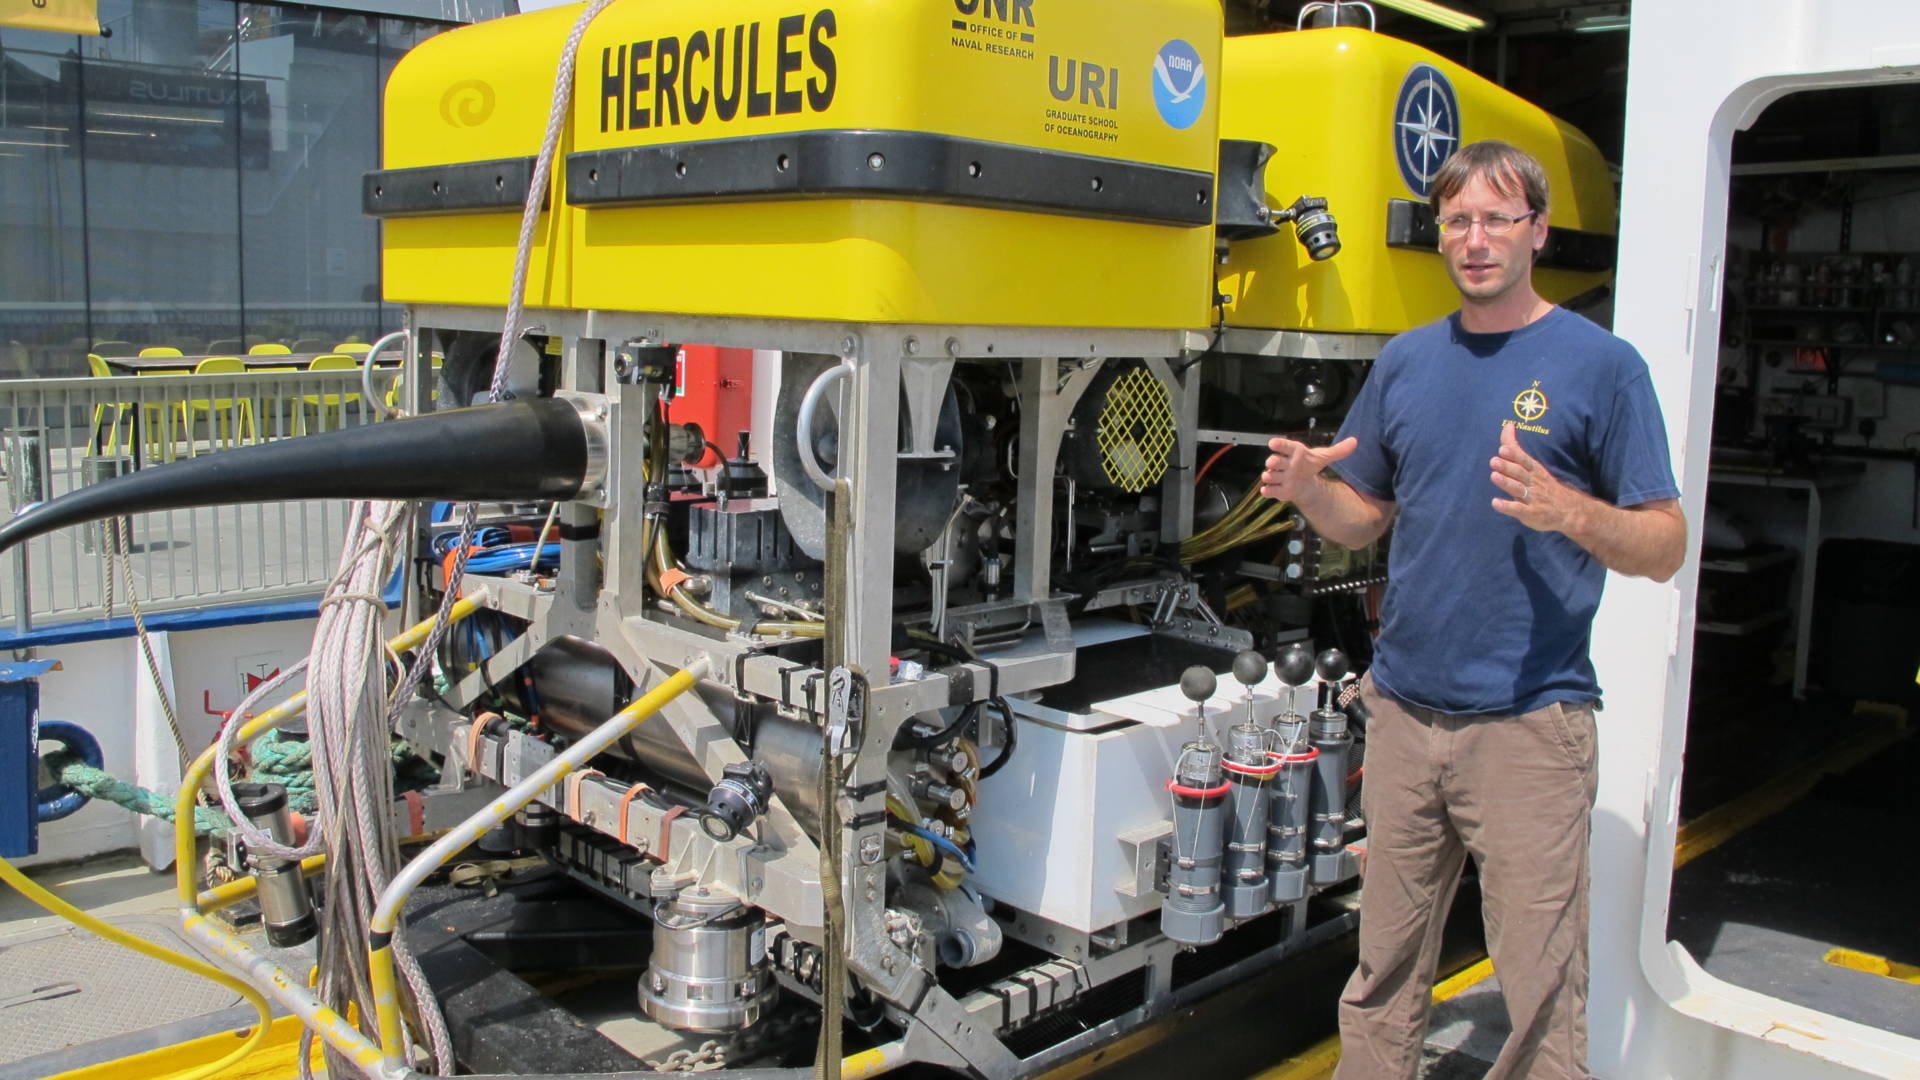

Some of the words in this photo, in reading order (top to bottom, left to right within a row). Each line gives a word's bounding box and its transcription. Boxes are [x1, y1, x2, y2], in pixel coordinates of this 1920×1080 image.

[970, 24, 1003, 38] OFFICE
[1006, 31, 1018, 40] OF
[952, 37, 982, 51] NAVAL
[985, 43, 1034, 60] RESEARCH
[600, 8, 837, 133] HERCULES
[1168, 55, 1192, 72] NOAA
[1048, 54, 1119, 110] URI
[1045, 109, 1086, 124] GRADUATE
[1088, 116, 1118, 129] SCHOOL
[1044, 124, 1055, 133] OF
[1057, 125, 1119, 142] OCEANOGRAPHY
[1516, 422, 1550, 434] Nautilus
